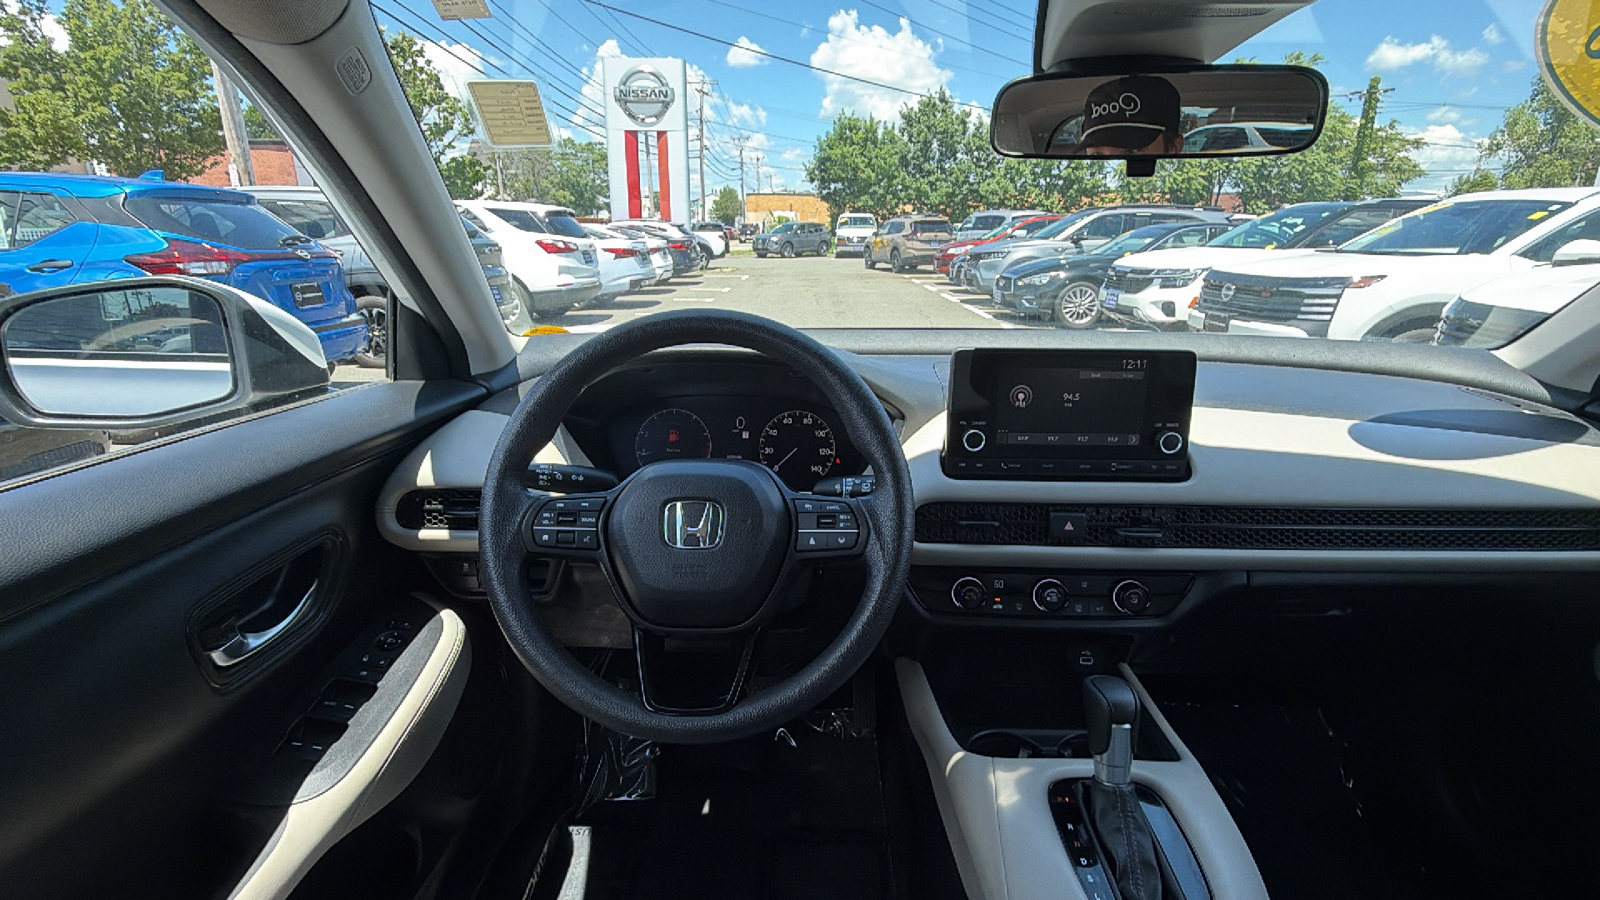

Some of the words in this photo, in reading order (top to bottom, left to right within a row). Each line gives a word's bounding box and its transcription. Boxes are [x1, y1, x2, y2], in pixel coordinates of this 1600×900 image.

[619, 89, 668, 99] NISSAN
[1121, 359, 1147, 369] 12:11
[1063, 393, 1081, 401] 94.5
[783, 417, 793, 425] 60
[802, 417, 813, 425] 80
[811, 465, 822, 473] 140
[993, 580, 1004, 589] 60
[1079, 857, 1088, 866] D
